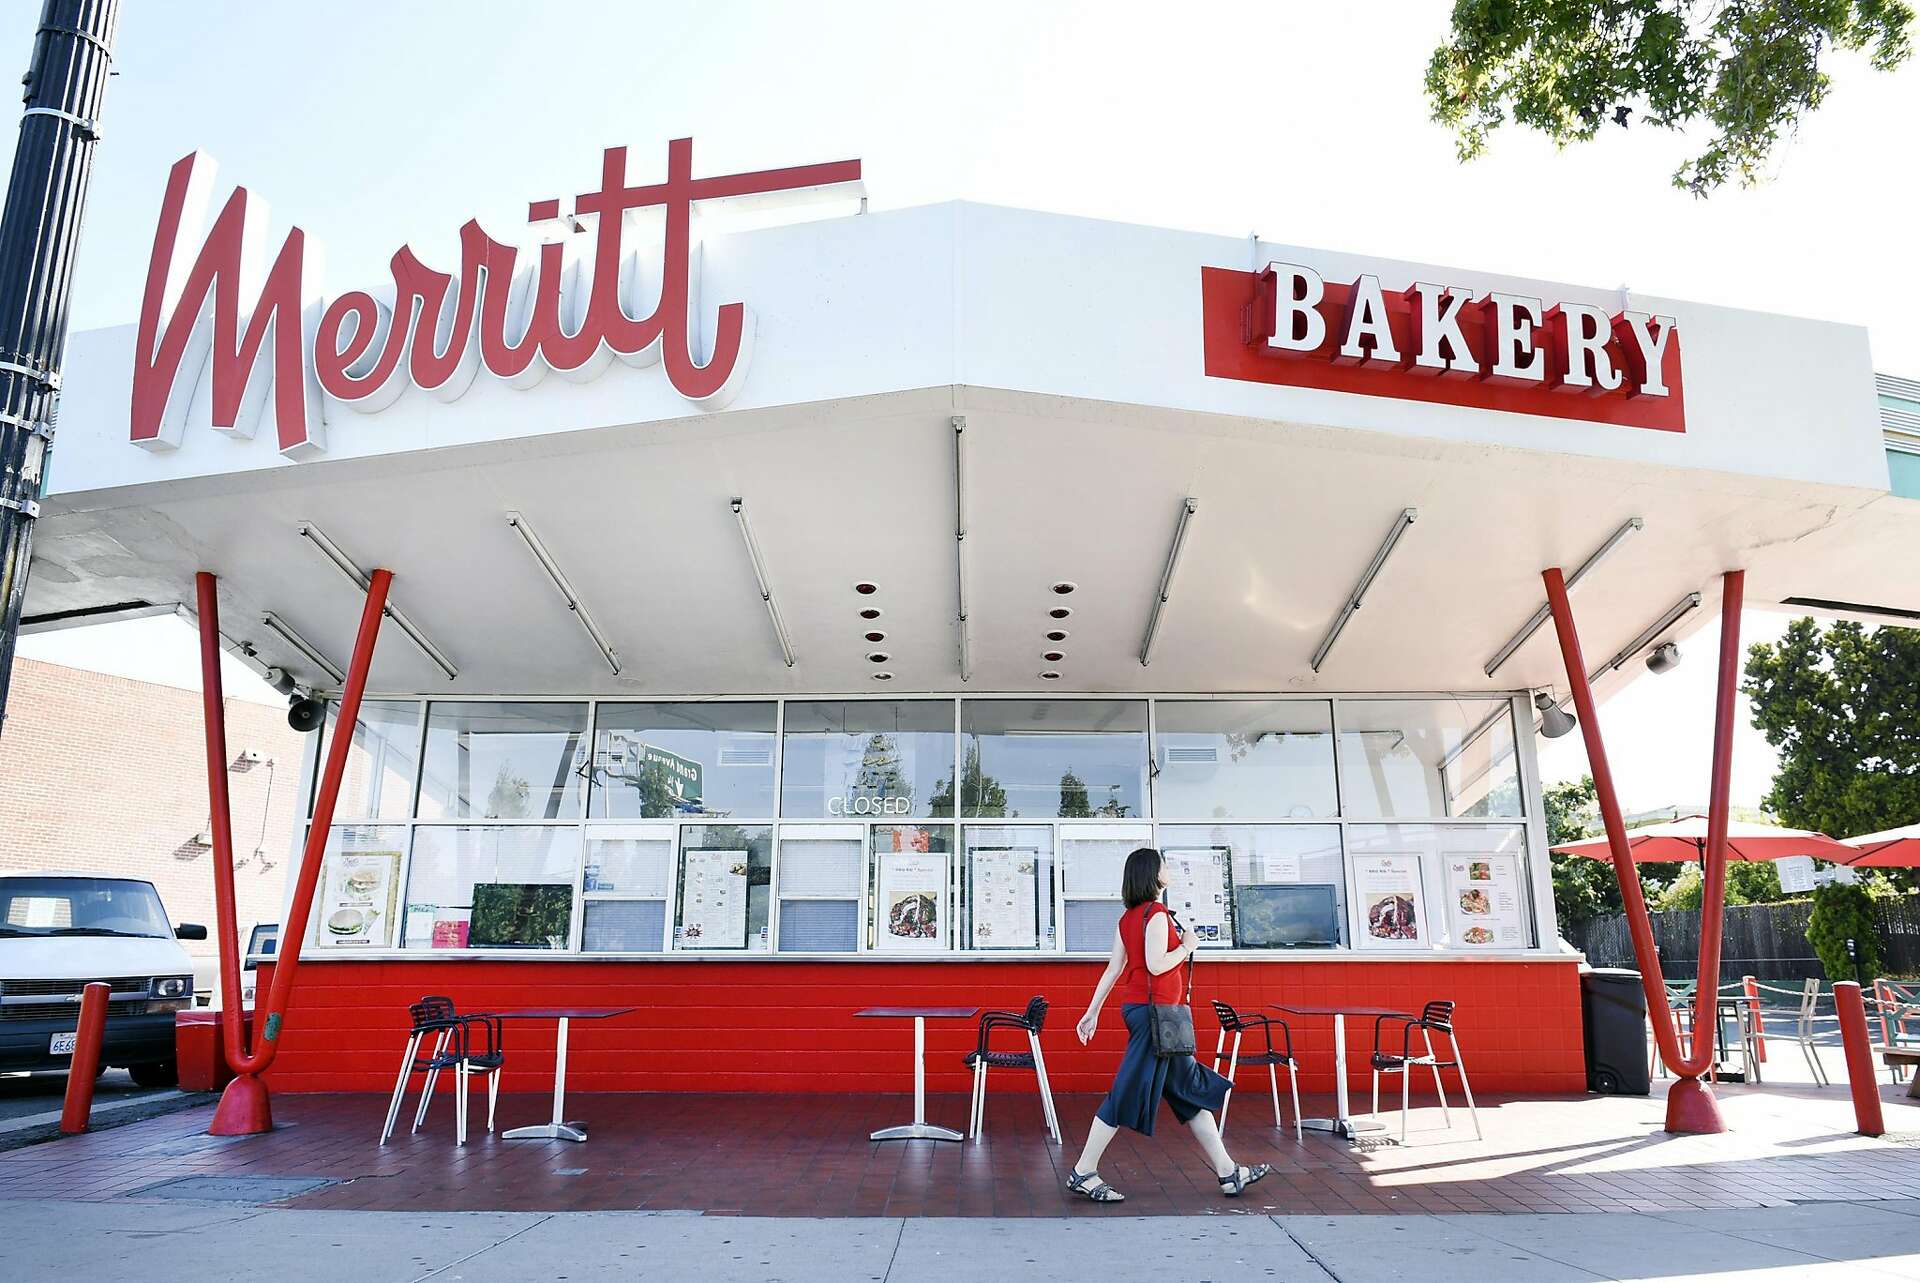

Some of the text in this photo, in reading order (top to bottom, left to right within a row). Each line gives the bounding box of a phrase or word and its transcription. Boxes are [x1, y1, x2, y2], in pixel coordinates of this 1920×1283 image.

[130, 136, 863, 456] Merritt
[1266, 261, 1677, 397] BAKERY
[827, 796, 910, 815] CLOSED
